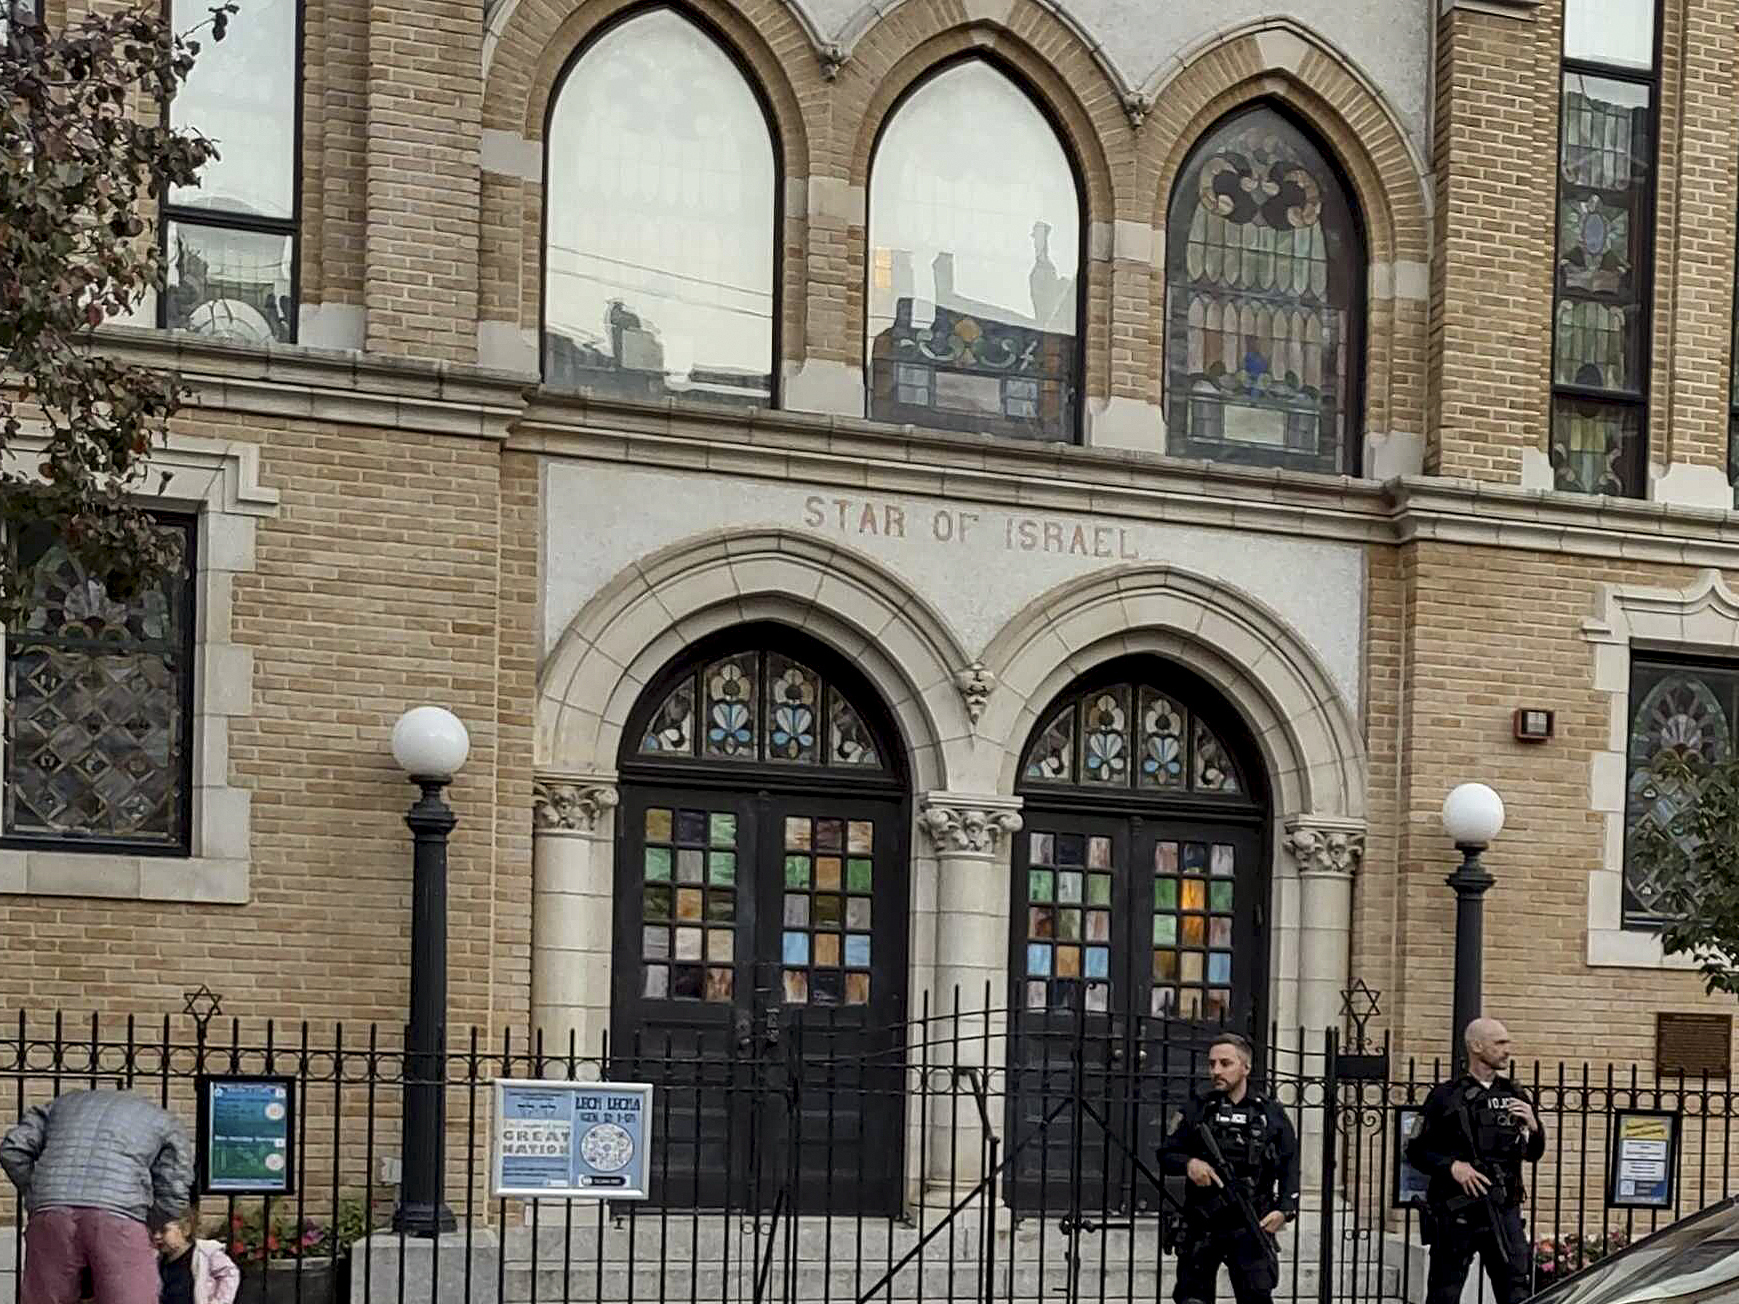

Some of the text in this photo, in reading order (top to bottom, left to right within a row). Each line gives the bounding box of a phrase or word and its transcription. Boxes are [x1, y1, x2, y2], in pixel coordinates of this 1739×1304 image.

[804, 495, 1140, 561] STAR OF ISRAEL
[503, 1130, 571, 1142] GREAT
[502, 1143, 570, 1155] NATION
